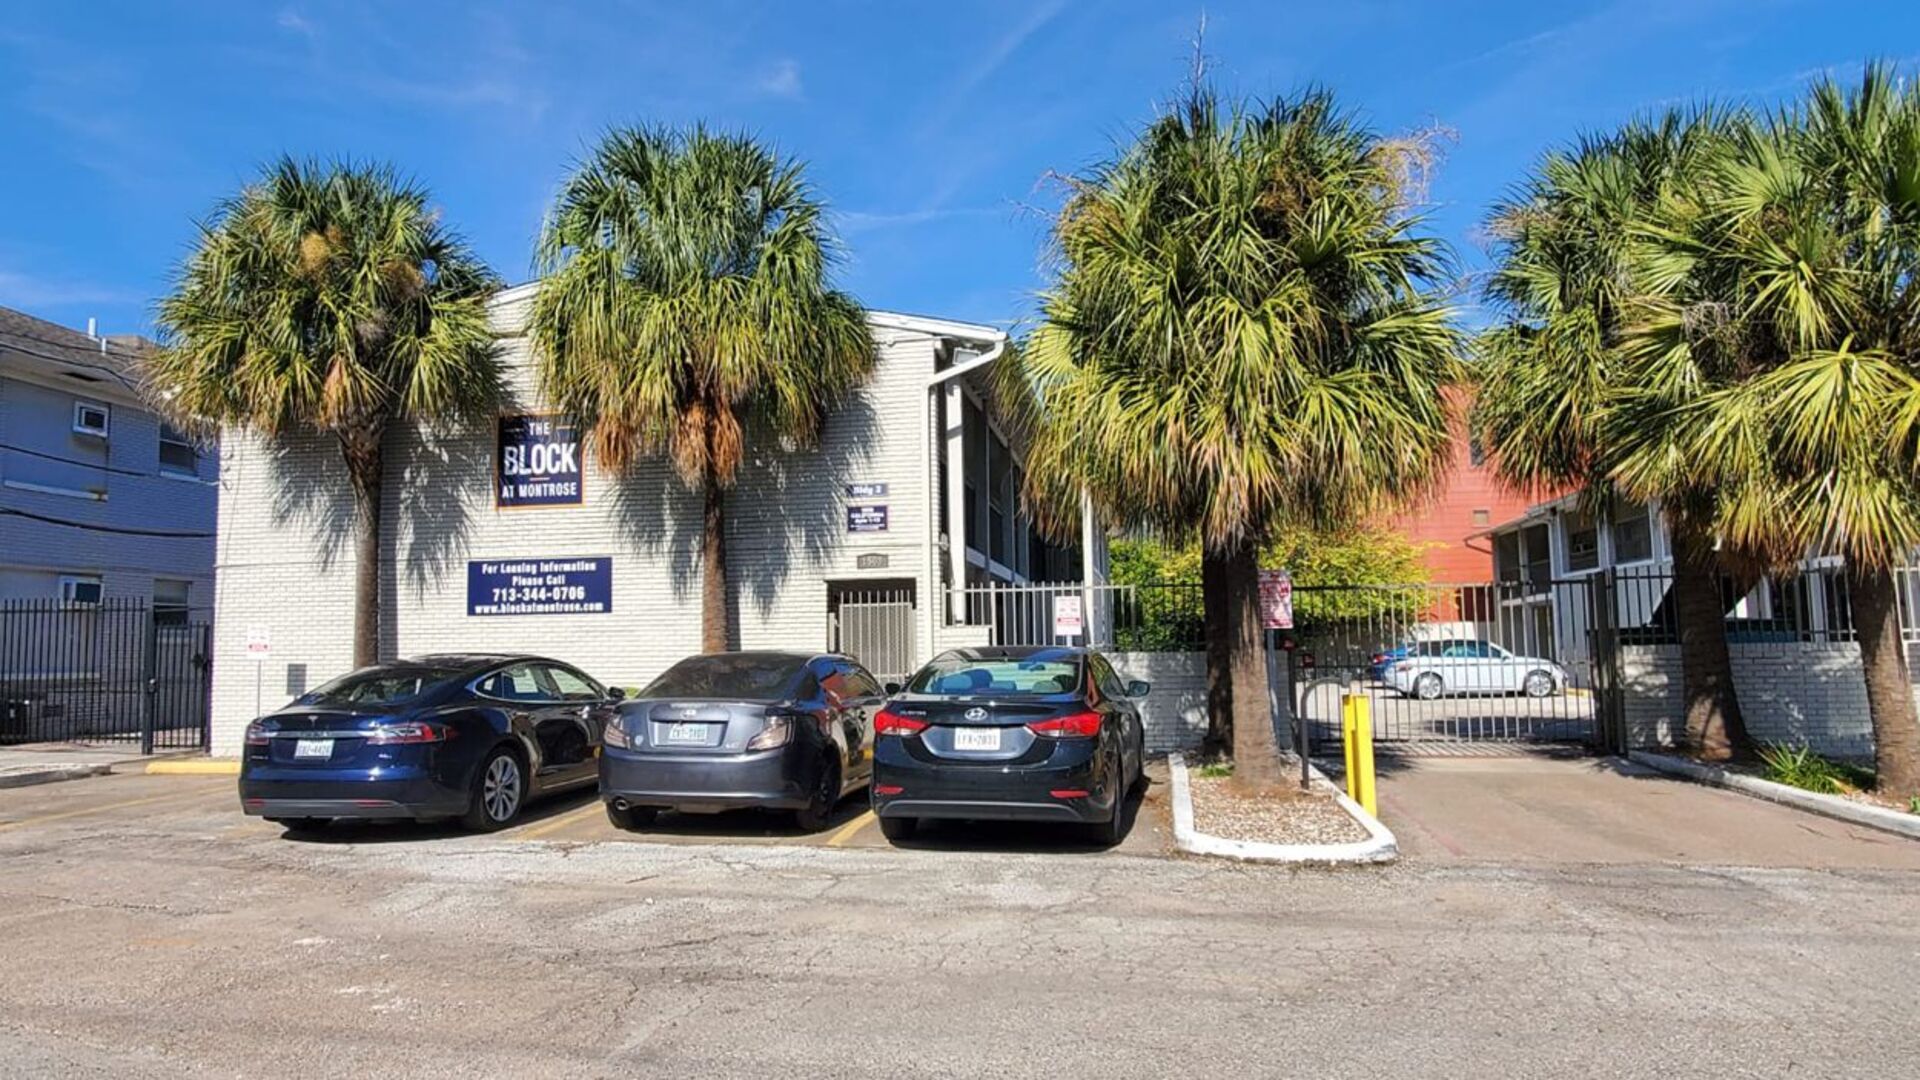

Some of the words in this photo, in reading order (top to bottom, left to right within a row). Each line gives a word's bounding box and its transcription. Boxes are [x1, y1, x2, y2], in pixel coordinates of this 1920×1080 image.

[529, 422, 550, 437] THE
[504, 442, 578, 476] BLOCK
[502, 484, 514, 499] AT
[518, 482, 577, 499] MONTROSE
[482, 563, 498, 574] For
[500, 562, 537, 575] Leasing
[540, 561, 597, 573] Information
[512, 575, 543, 586] Please
[546, 574, 566, 585] Call
[492, 586, 585, 602] 713-344-0706
[474, 602, 604, 615] www.blockatmontrose.com
